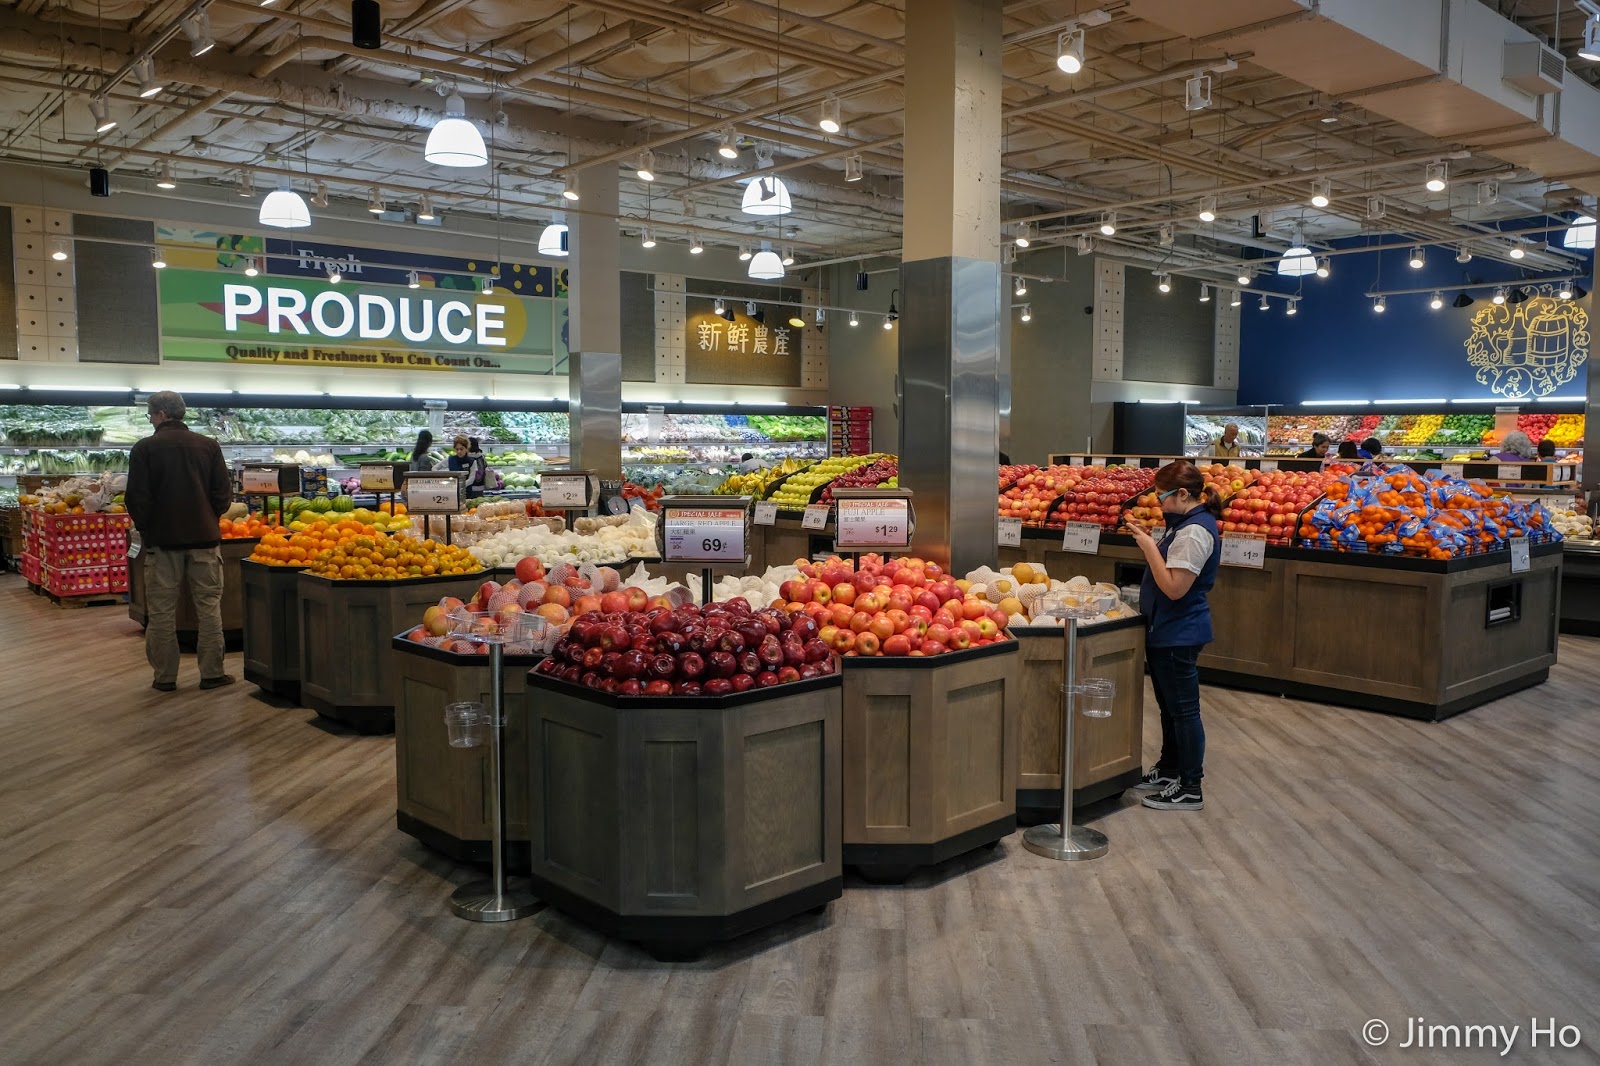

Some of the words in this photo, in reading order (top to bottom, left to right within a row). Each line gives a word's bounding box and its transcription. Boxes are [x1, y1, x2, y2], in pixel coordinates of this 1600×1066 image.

[297, 249, 363, 273] Fresh
[223, 283, 507, 347] PRODUCE
[697, 320, 791, 356] 新鮮農產
[225, 345, 280, 361] Quality
[283, 349, 309, 360] and
[312, 349, 378, 363] Freshness
[381, 352, 404, 364] You
[407, 354, 432, 365] Can
[434, 355, 470, 367] Count
